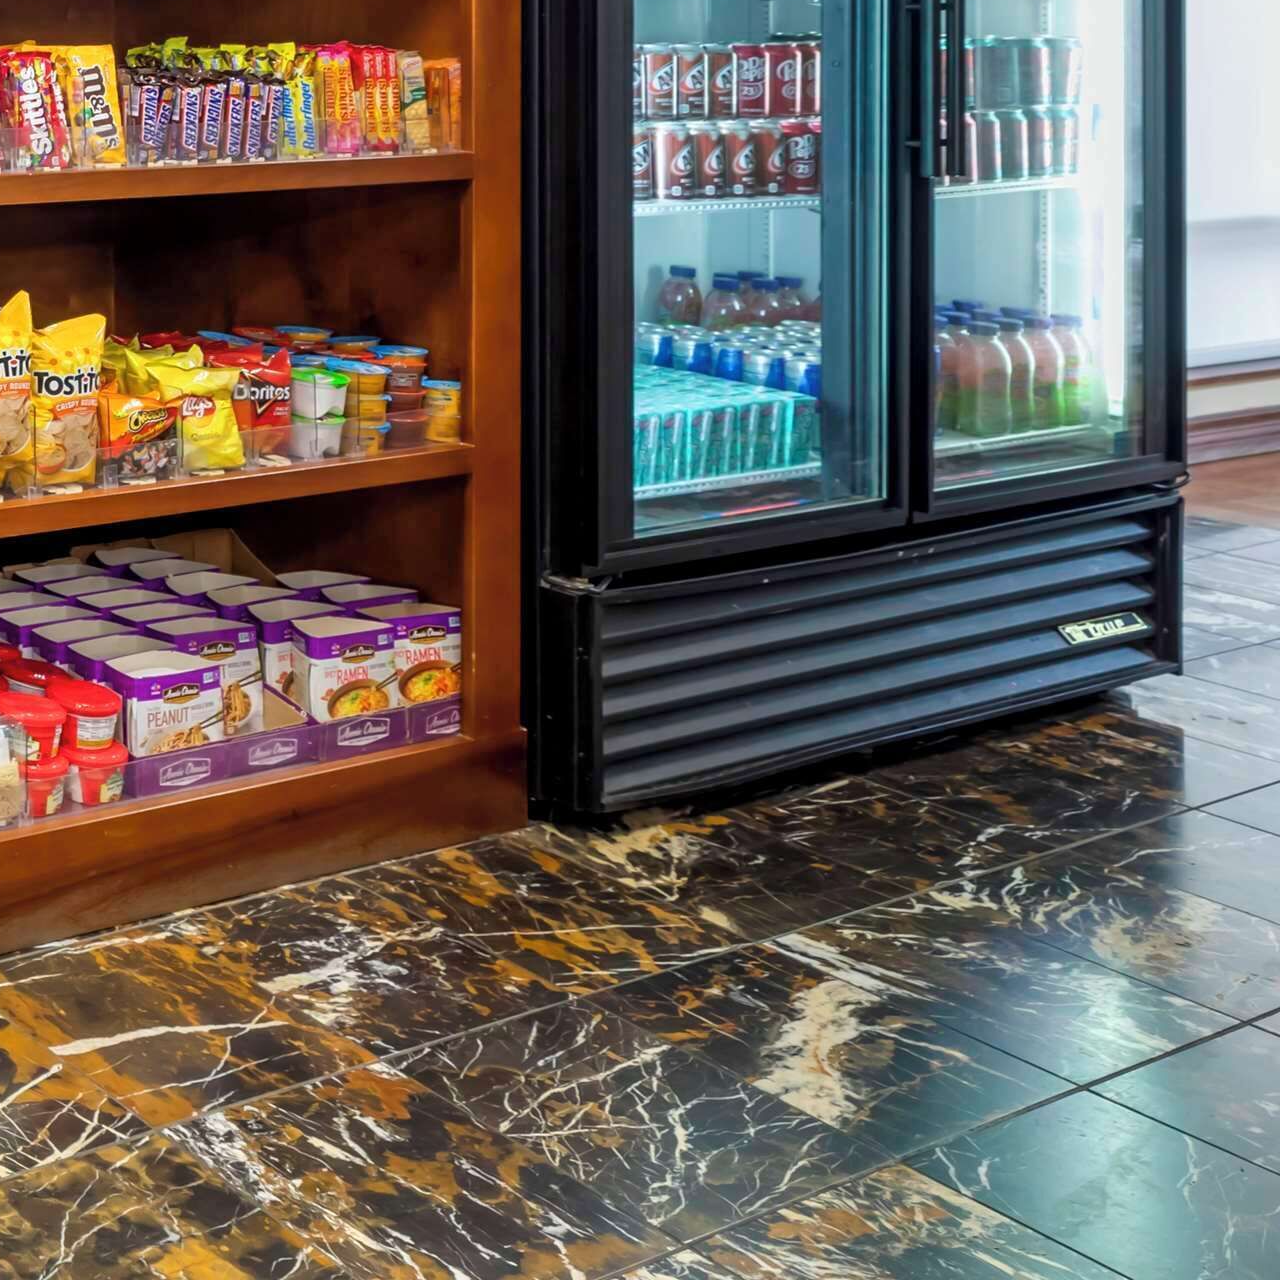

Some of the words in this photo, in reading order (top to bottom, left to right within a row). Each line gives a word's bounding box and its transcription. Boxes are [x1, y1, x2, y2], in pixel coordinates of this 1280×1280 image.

[20, 65, 53, 155] Skittles
[143, 87, 158, 143] SNICKERS
[184, 91, 199, 150] SNICKERS
[205, 88, 223, 146] SNICKERS
[227, 99, 242, 155] SNICKERS
[247, 101, 261, 156] SNICKERS
[300, 80, 316, 150] Butterfinger
[233, 383, 290, 400] Doritos
[336, 666, 368, 686] RAMEN
[405, 647, 441, 665] RAMEN
[147, 707, 190, 728] PEANUT
